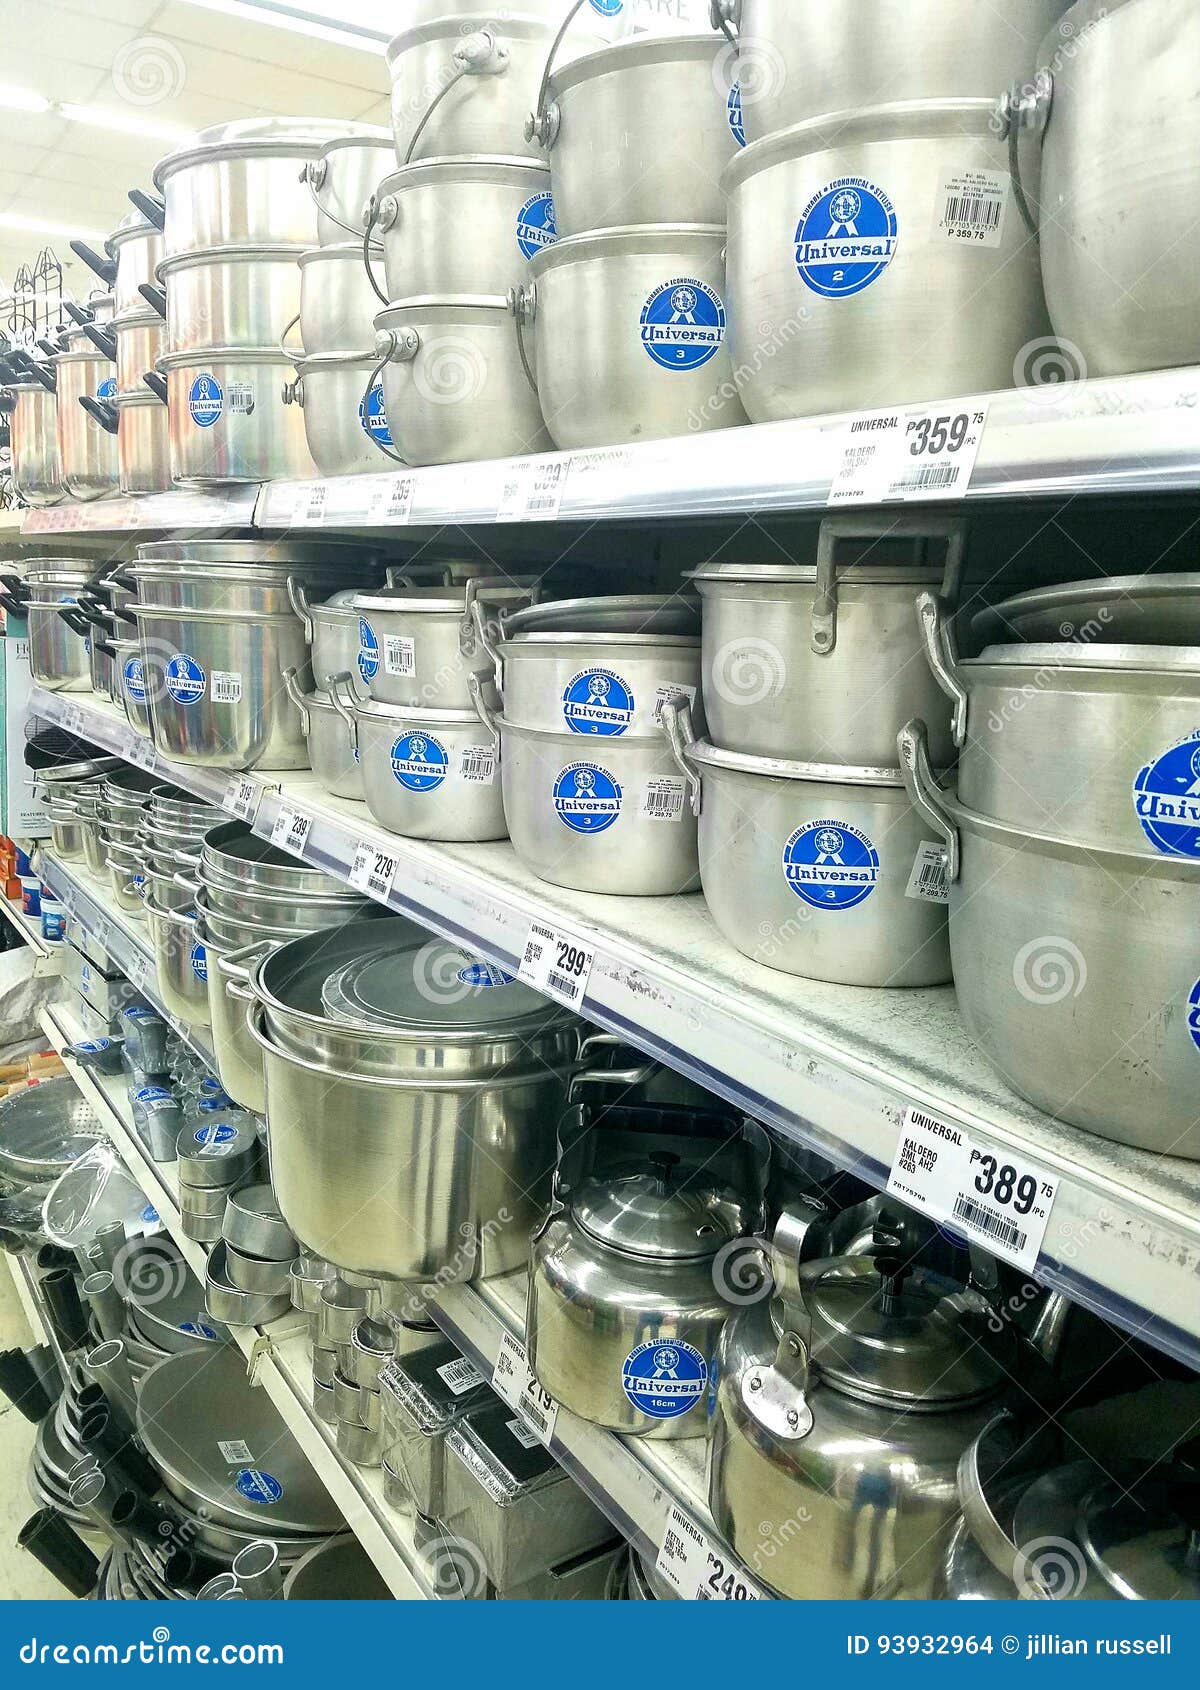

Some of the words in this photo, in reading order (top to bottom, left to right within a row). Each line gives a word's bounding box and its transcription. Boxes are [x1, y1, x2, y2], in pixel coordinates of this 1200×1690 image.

[802, 190, 823, 218] DURABLE
[829, 178, 869, 190] ECONOMICAL
[873, 188, 894, 213] STYLISH
[956, 230, 985, 240] 359.75
[795, 240, 892, 264] Universal
[832, 270, 844, 281] 2
[646, 285, 664, 306] DURABLE
[670, 278, 703, 288] ECONOMICAL
[706, 288, 722, 308] STYLISH
[641, 326, 722, 342] Universal
[675, 350, 685, 359] 3
[851, 416, 898, 433] UNIVERSAL
[972, 413, 984, 425] 75
[166, 678, 205, 690] Universal
[563, 702, 631, 723] Universal
[391, 758, 447, 775] Universal
[555, 798, 621, 811] Universal
[788, 825, 807, 845] DURABLE
[812, 820, 849, 830] ECONOMICAL
[853, 830, 873, 848] STYLISH
[786, 864, 877, 882] Universal
[825, 890, 836, 898] 3
[531, 923, 555, 942] UNIVERSAL
[911, 1111, 963, 1147] UNIVERSAL
[901, 1147, 917, 1163] SML
[918, 1156, 934, 1172] AH2
[903, 1138, 938, 1163] KALDERO
[898, 1158, 917, 1174] #263
[1040, 1182, 1054, 1198] 75
[1032, 1206, 1045, 1218] /PC
[503, 1335, 526, 1362] UNIVERSAL
[624, 1376, 704, 1393] Universal
[672, 1508, 704, 1548] UNIVERSAL
[667, 1528, 685, 1551] KETTLE
